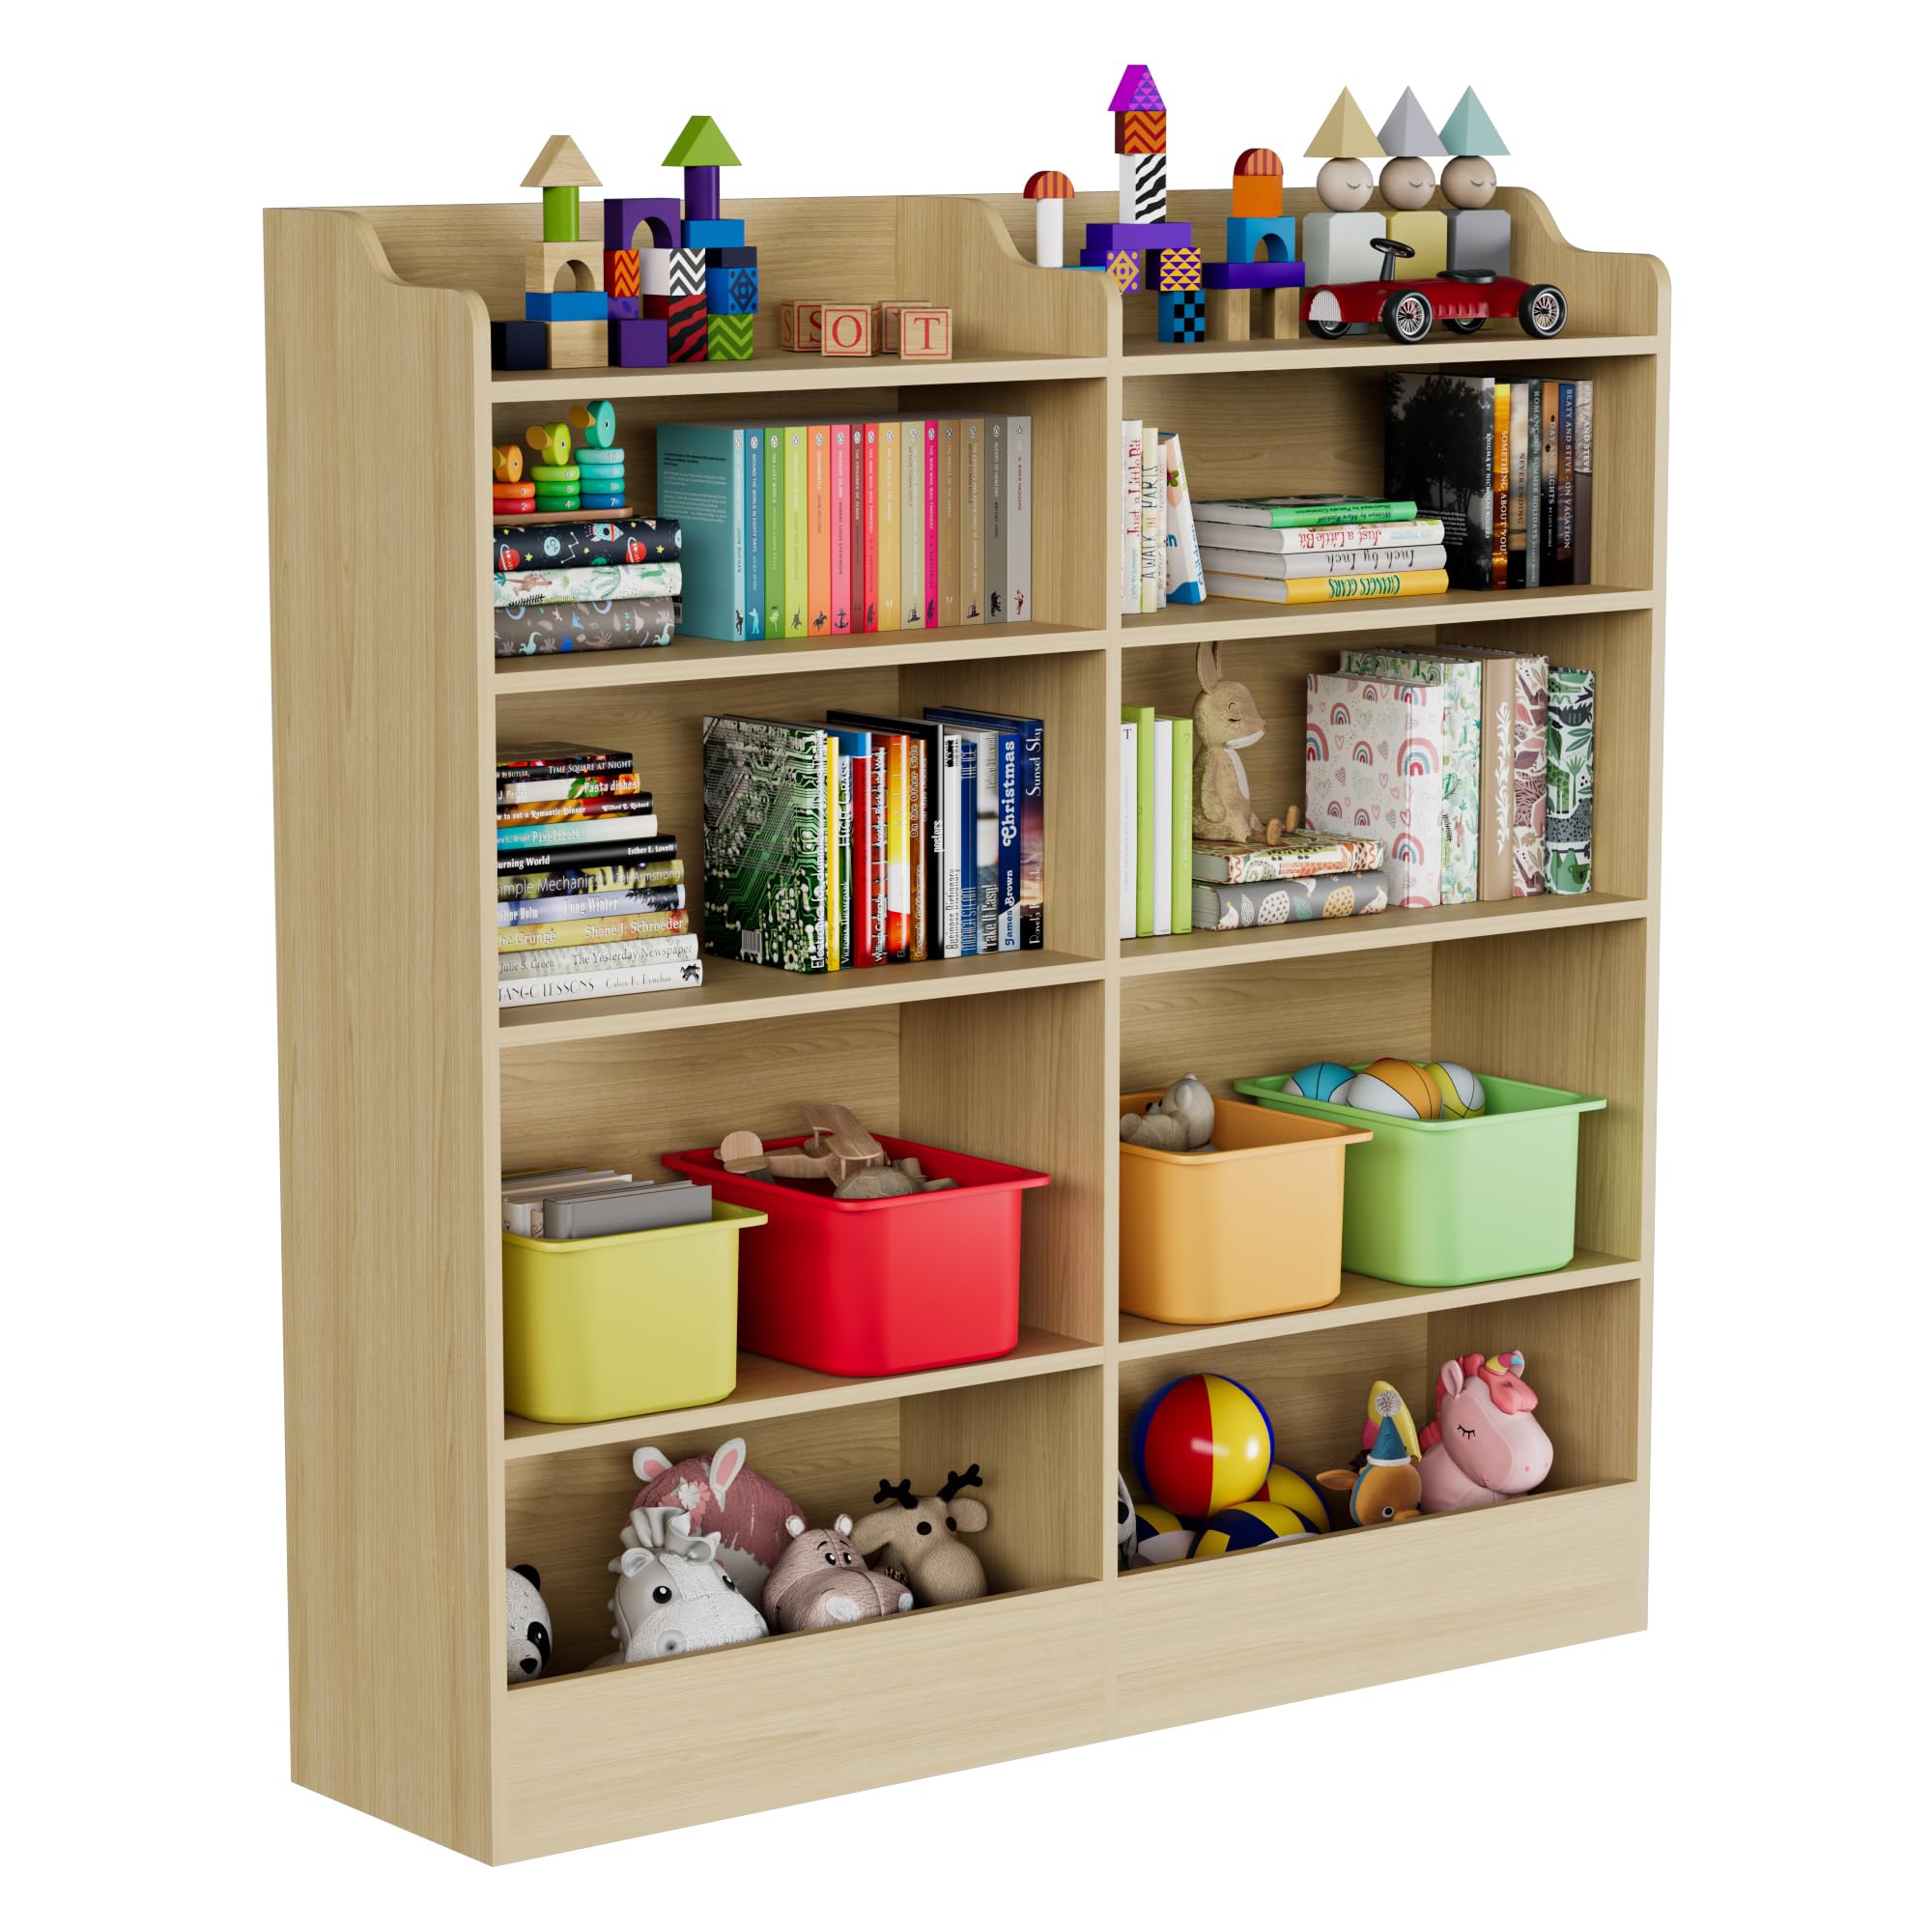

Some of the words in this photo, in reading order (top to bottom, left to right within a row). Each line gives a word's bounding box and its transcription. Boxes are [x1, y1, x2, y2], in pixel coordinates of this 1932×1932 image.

[832, 314, 863, 349] O
[913, 317, 941, 350] T
[1127, 438, 1141, 458] Bit
[1127, 458, 1141, 495] Little
[1485, 463, 1492, 471] BY
[610, 482, 615, 491] 8
[1142, 466, 1157, 508] PARIS
[1565, 481, 1573, 496] ON
[521, 501, 526, 510] 2
[565, 499, 571, 508] 4
[610, 497, 616, 506] 7
[1127, 510, 1141, 537] Just
[1297, 532, 1316, 550] Bit
[1316, 531, 1346, 549] Little
[1347, 531, 1354, 541] a
[1358, 530, 1382, 547] Just
[1142, 533, 1157, 569] WALK
[1363, 549, 1379, 570] by
[1383, 550, 1414, 569] Inch
[1324, 553, 1356, 573] Inch
[1328, 578, 1358, 599] GEARS
[1359, 574, 1401, 596] CHANGES
[1025, 727, 1043, 753] Sky
[1122, 728, 1133, 740] T
[910, 744, 919, 769] Side
[960, 749, 977, 763] ICE
[549, 765, 566, 775] TIME
[567, 763, 596, 774] SQUARE
[597, 762, 606, 771] AT
[608, 759, 634, 770] NIGHT
[960, 766, 977, 781] THE
[1025, 756, 1043, 797] Sunset
[584, 781, 609, 794] Pasta
[611, 779, 638, 791] dishes
[838, 760, 852, 805] GRASS
[910, 771, 919, 802] Other
[874, 793, 884, 814] Brick
[1001, 741, 1017, 848] Christmas
[530, 808, 561, 819] Romantic
[563, 806, 587, 816] Dinner
[910, 803, 919, 821] the
[874, 814, 884, 847] Another
[910, 823, 919, 838] On
[930, 819, 945, 854] posters
[628, 845, 647, 856] Esther
[648, 845, 655, 854] E.
[656, 843, 675, 853] Lovett
[810, 829, 825, 881] dummies
[497, 858, 525, 870] urning
[526, 855, 551, 867] World
[537, 873, 601, 894] Mechanics
[634, 867, 681, 883] Armstrong
[810, 884, 825, 901] for
[945, 867, 960, 911] Dictionary
[980, 883, 999, 912] Easy!
[1005, 868, 1015, 907] Brown
[520, 906, 540, 921] Holm
[587, 896, 619, 914] Winter
[585, 923, 617, 939] Shane
[619, 922, 628, 936] J.
[630, 917, 685, 935] Schroeder
[980, 913, 999, 923] It
[1005, 909, 1015, 947] James
[1029, 911, 1041, 945] Ravela
[514, 930, 557, 946] Grunge
[810, 904, 825, 969] Electronics
[945, 912, 960, 950] Business
[980, 923, 999, 950] Take
[573, 952, 590, 966] The
[592, 947, 639, 964] Yesterday
[640, 943, 694, 961] Newspaper
[874, 932, 884, 962] William
[500, 961, 520, 974] Julie
[521, 960, 529, 971] S.
[530, 957, 555, 969] Green
[542, 979, 595, 999] LESSONS
